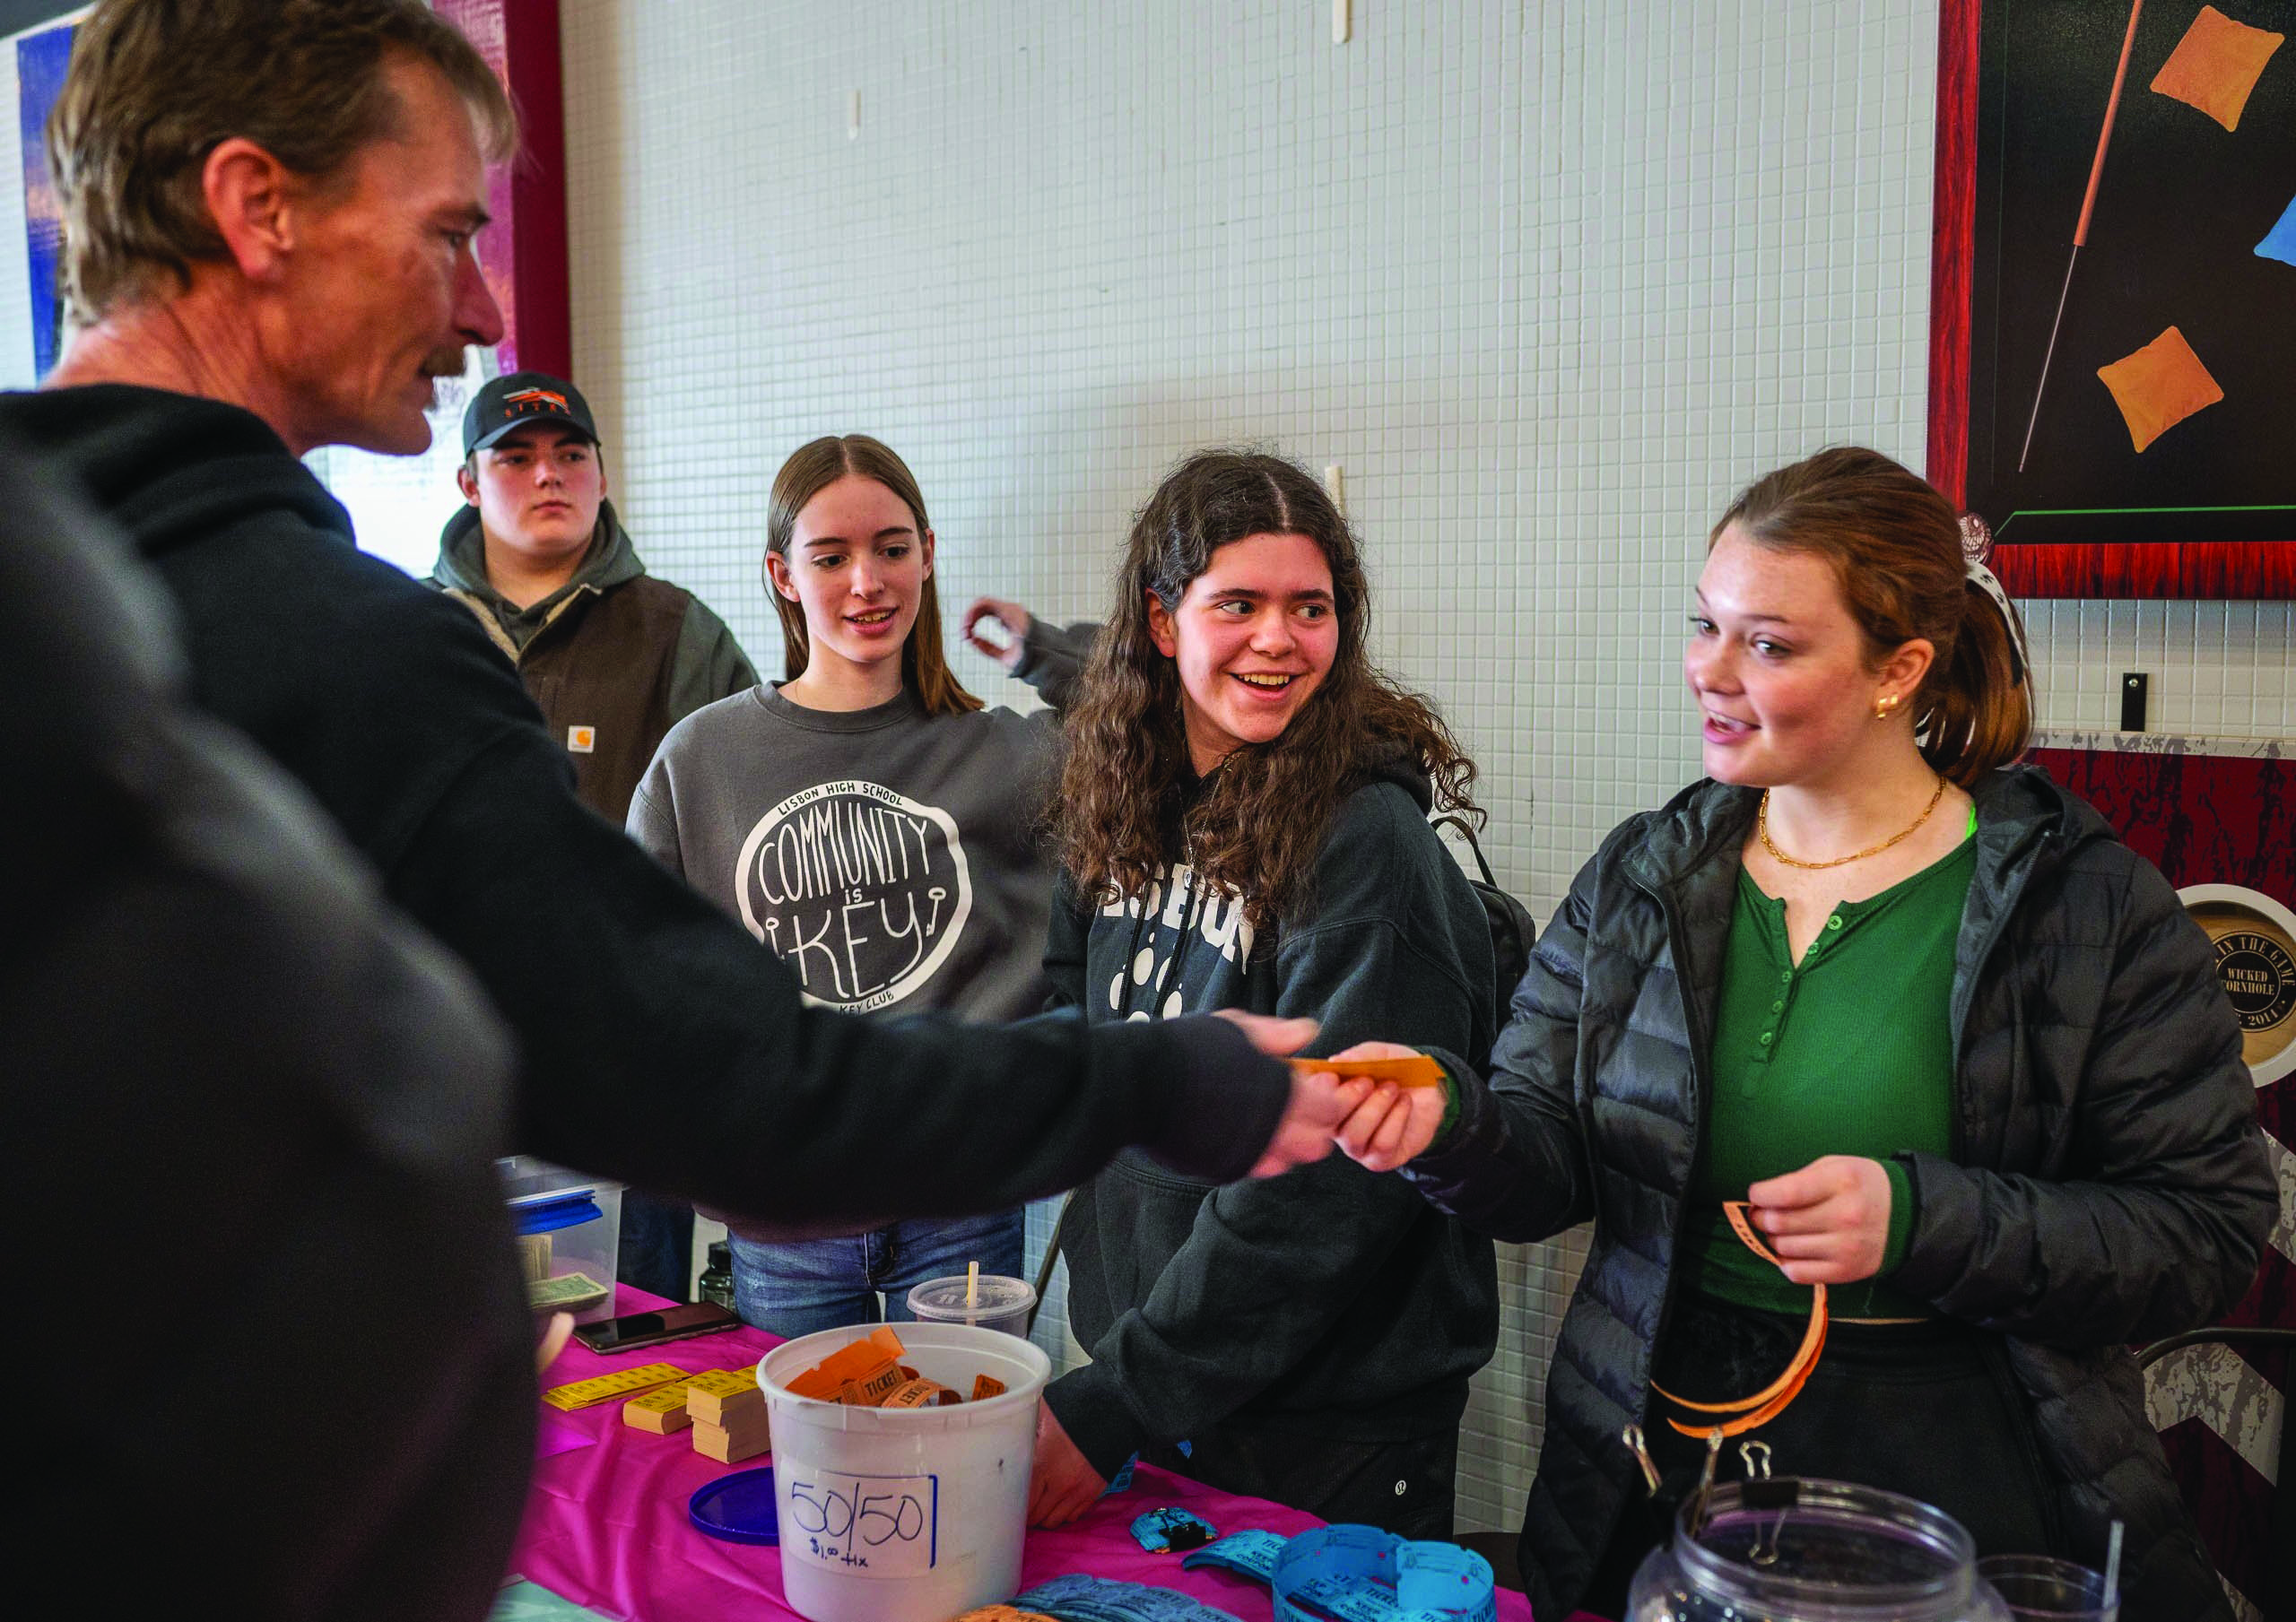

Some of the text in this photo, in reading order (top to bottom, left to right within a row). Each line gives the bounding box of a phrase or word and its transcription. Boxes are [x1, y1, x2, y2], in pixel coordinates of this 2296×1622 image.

[778, 782, 902, 816] LISBON HIGH SCHOOL
[759, 800, 929, 905] COMMUNITY
[845, 888, 863, 905] is
[787, 891, 923, 999] KEY
[2239, 936, 2268, 954] THE
[2270, 950, 2295, 985] GAME
[2227, 967, 2268, 983] WICKED
[839, 991, 894, 1016] KEY CLUB
[864, 1369, 896, 1397] TICKET
[789, 1482, 924, 1552] 50/50
